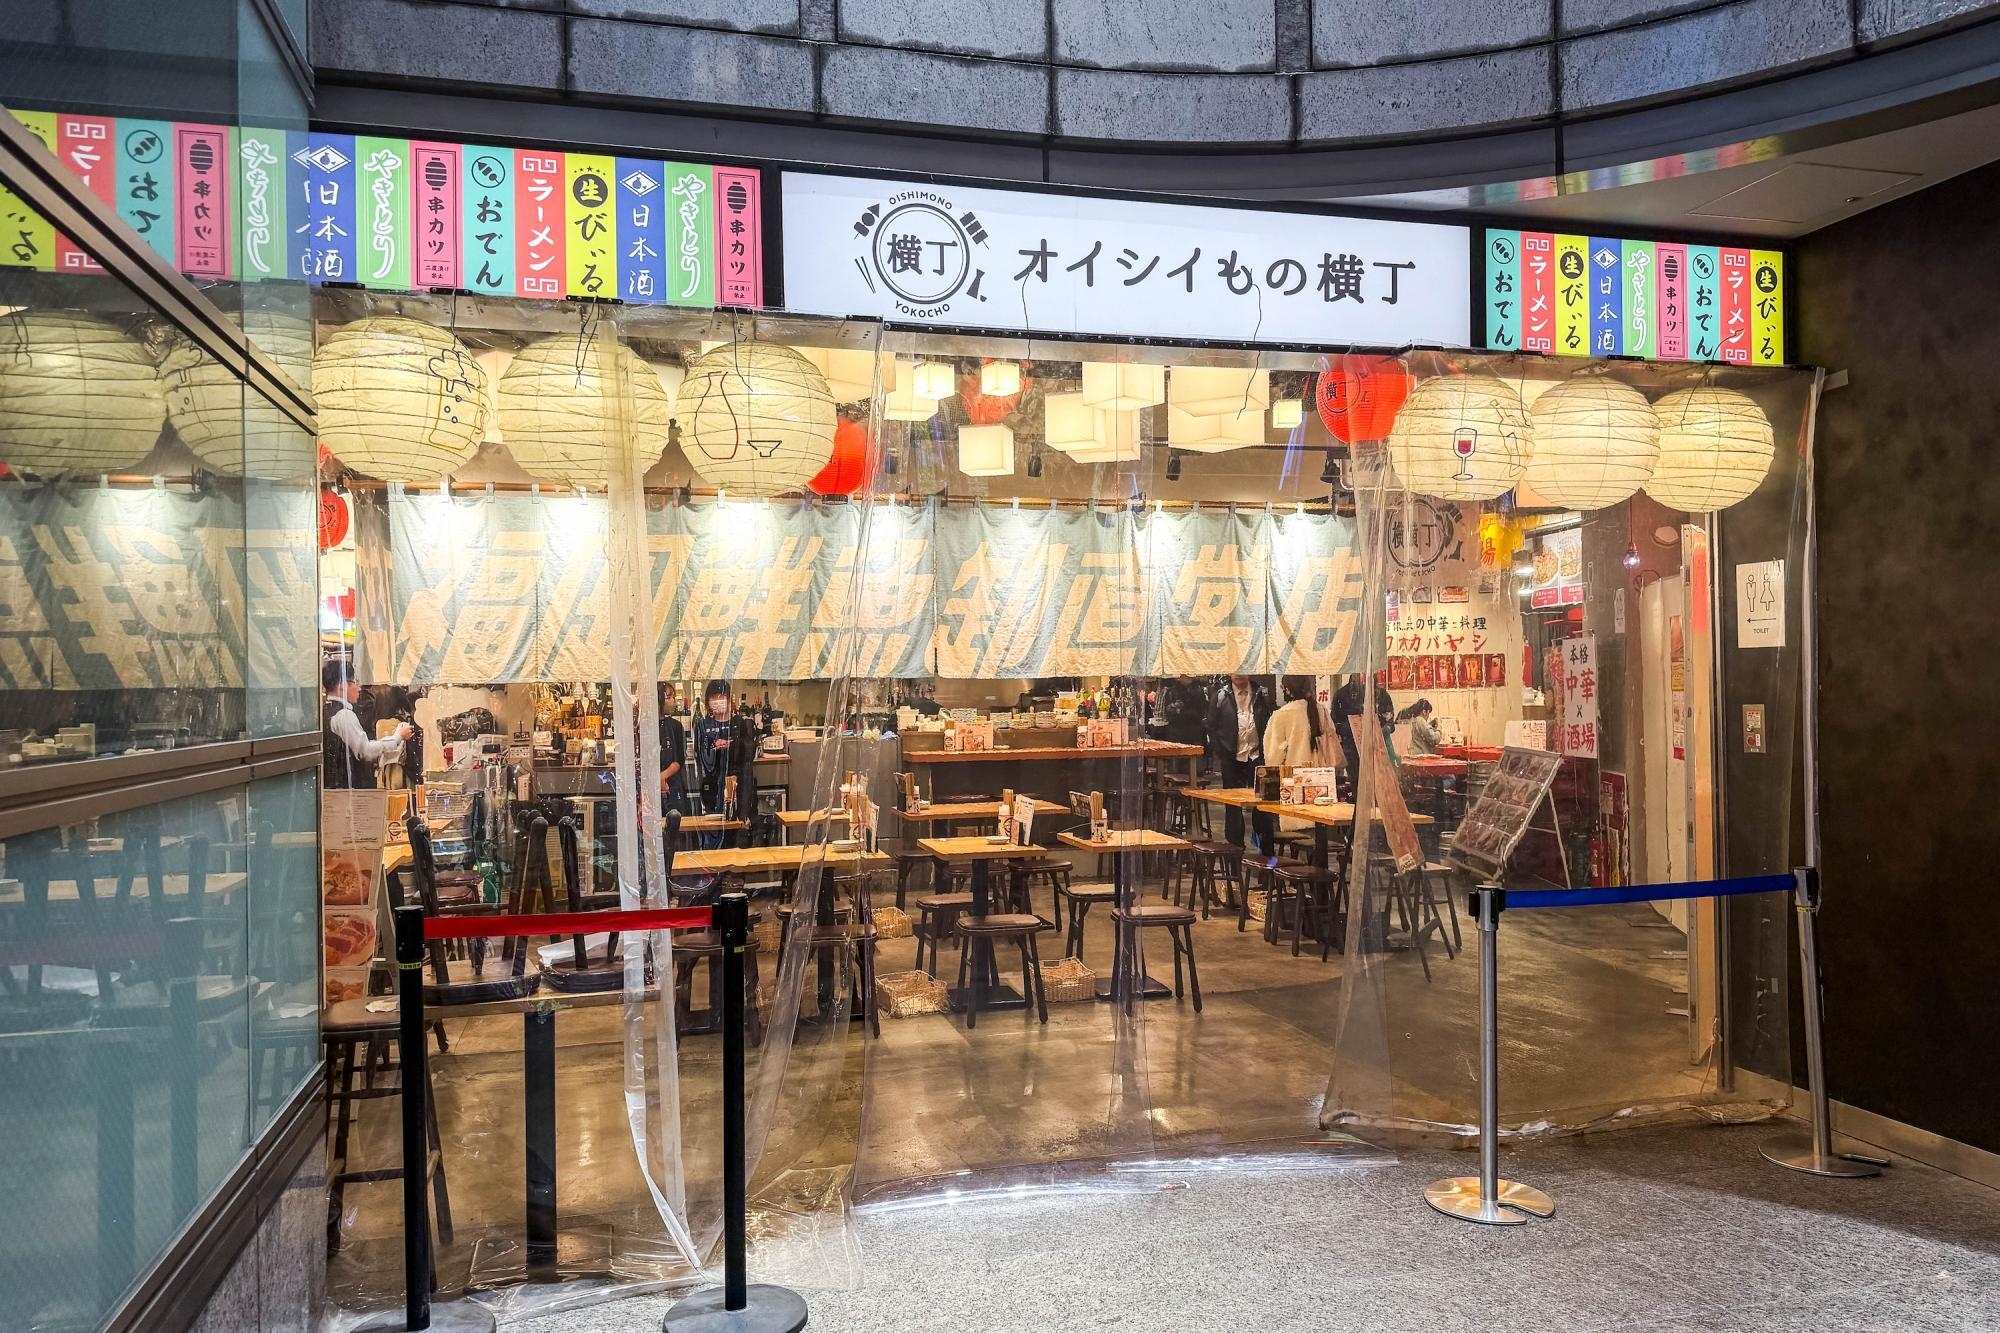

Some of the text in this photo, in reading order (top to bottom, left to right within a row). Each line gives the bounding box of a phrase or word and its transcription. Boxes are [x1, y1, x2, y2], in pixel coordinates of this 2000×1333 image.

[315, 181, 348, 278] 日本酒
[363, 148, 402, 280] やきとり
[427, 196, 446, 256] 串カツ
[527, 178, 556, 271] ラーメン
[671, 173, 707, 298] やきとり
[888, 191, 953, 210] OISHIMONO
[474, 195, 503, 288] おでん
[628, 204, 658, 296] 日本酒
[728, 219, 746, 276] 串カツ
[886, 233, 958, 276] 横丁
[1014, 237, 1417, 305] オイシイもの横丁
[895, 300, 950, 318] YOKOCHO
[1494, 270, 1513, 347] おでん
[1529, 255, 1549, 333] ラーメン
[1597, 275, 1618, 352] 日本酒
[1626, 250, 1651, 352] やきとり
[1665, 286, 1678, 333] 串カツ
[1695, 286, 1714, 358] おでん
[1727, 270, 1746, 344] ラーメン
[1569, 644, 1590, 666] 本格
[1752, 627, 1770, 635] TOILET
[1565, 667, 1596, 704] 中華
[1566, 722, 1596, 753] 酒場
